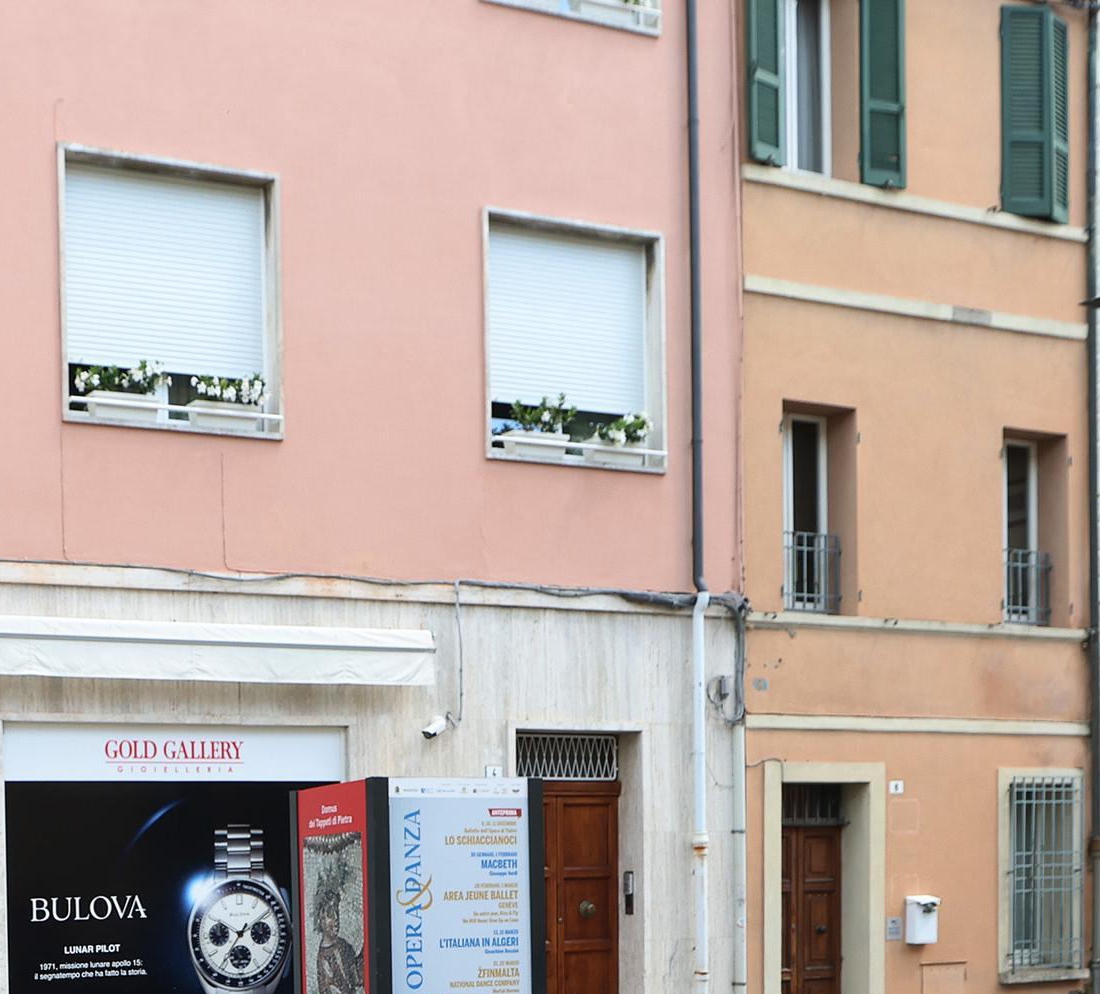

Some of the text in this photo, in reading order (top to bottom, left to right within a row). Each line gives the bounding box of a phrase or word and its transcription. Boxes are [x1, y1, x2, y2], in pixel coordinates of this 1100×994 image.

[104, 740, 244, 759] GOLD GALLERY
[445, 835, 517, 845] LO SCHIACCIANOCI
[404, 809, 422, 893] DANZA
[481, 859, 518, 869] MACBETH
[396, 874, 433, 910] &
[444, 890, 518, 901] AREA JEUNE BALLET
[30, 894, 147, 922] BULOVA
[405, 904, 424, 990] OPERA
[439, 937, 519, 948] L'ITALIANA IN ALGERI
[64, 944, 120, 954] LUNAR PILOT
[40, 963, 58, 971] 1971,
[60, 961, 88, 969] missione
[90, 960, 110, 968] lunare
[112, 960, 131, 968] apollo
[40, 971, 80, 980] segnatempo
[82, 970, 93, 978] che
